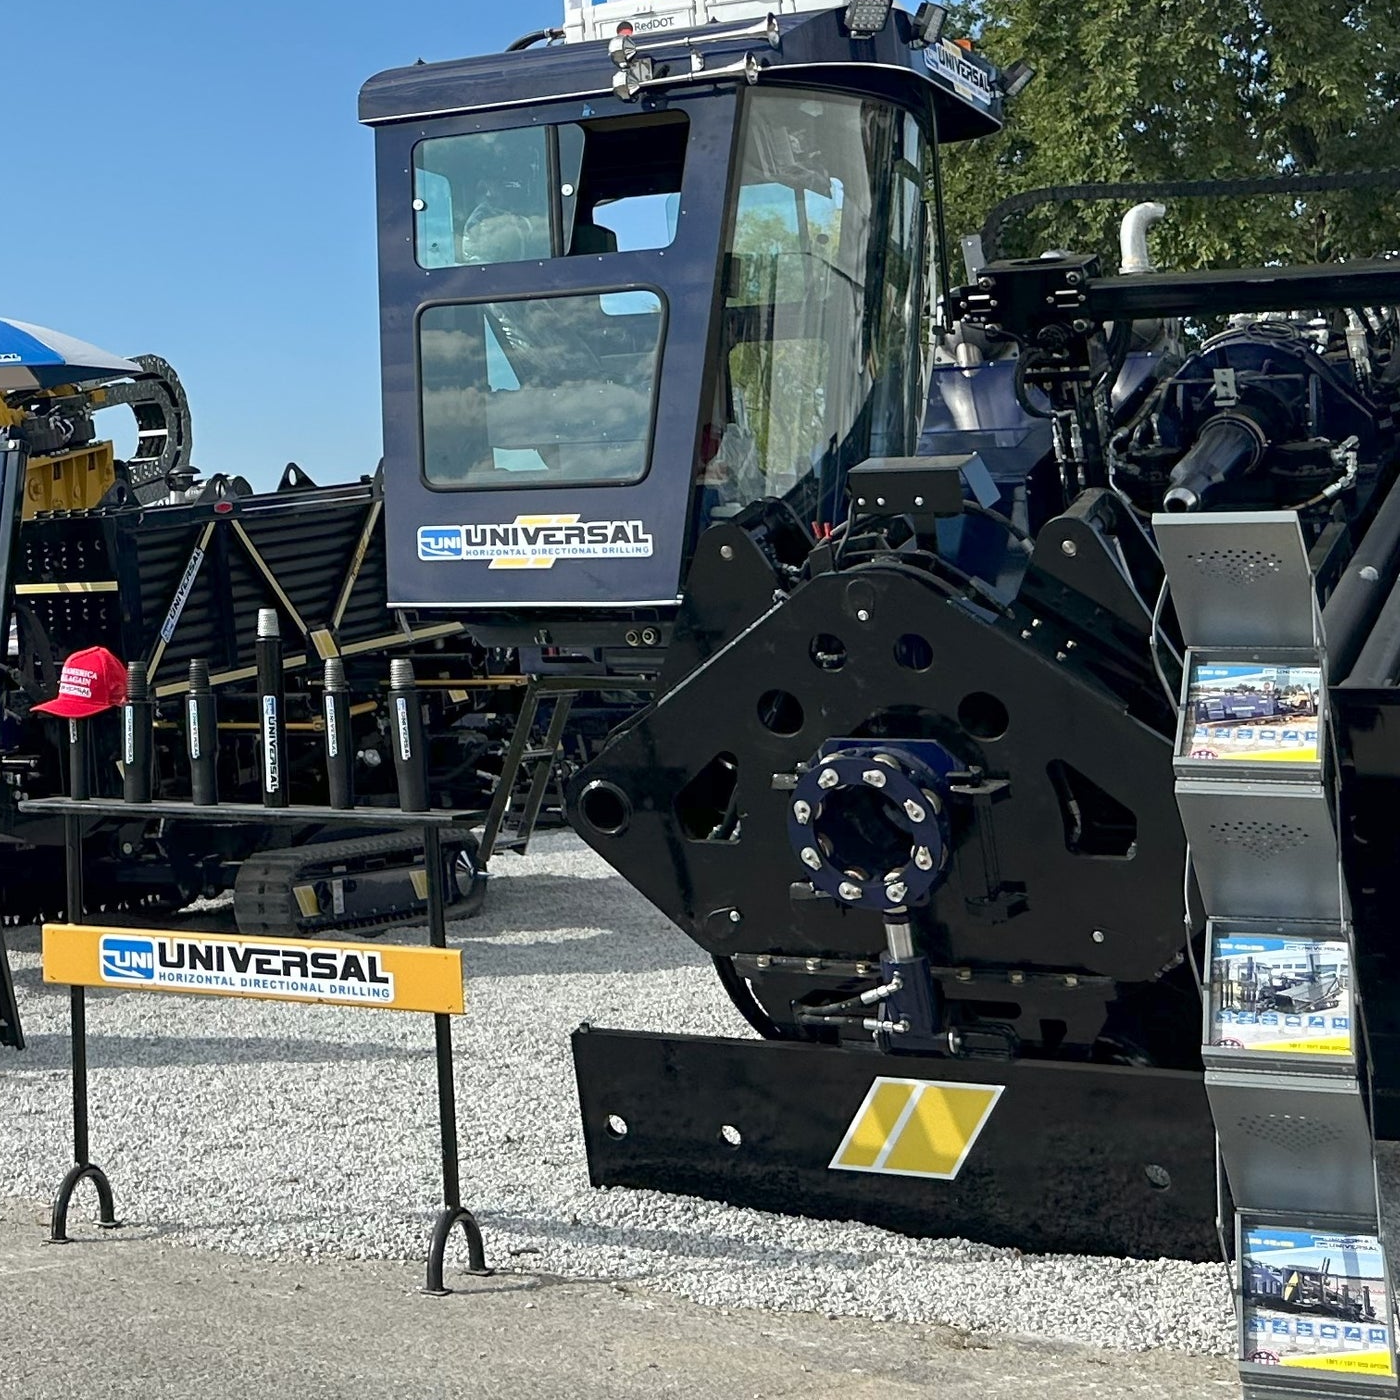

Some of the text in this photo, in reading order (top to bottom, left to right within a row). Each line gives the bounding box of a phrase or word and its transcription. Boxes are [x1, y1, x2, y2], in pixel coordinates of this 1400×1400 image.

[634, 16, 675, 31] RedDOT
[465, 522, 649, 547] UNIVERSAL
[466, 545, 650, 556] HORIZONTAL DIRECTIONAL DRILLING
[170, 550, 203, 619] UNIVERSAL
[268, 716, 279, 790] UNIVERSAL
[103, 941, 389, 984] UNI UNIVERSAL
[158, 971, 390, 998] HORIZONTAL DIRECTIONAL DRILLING
